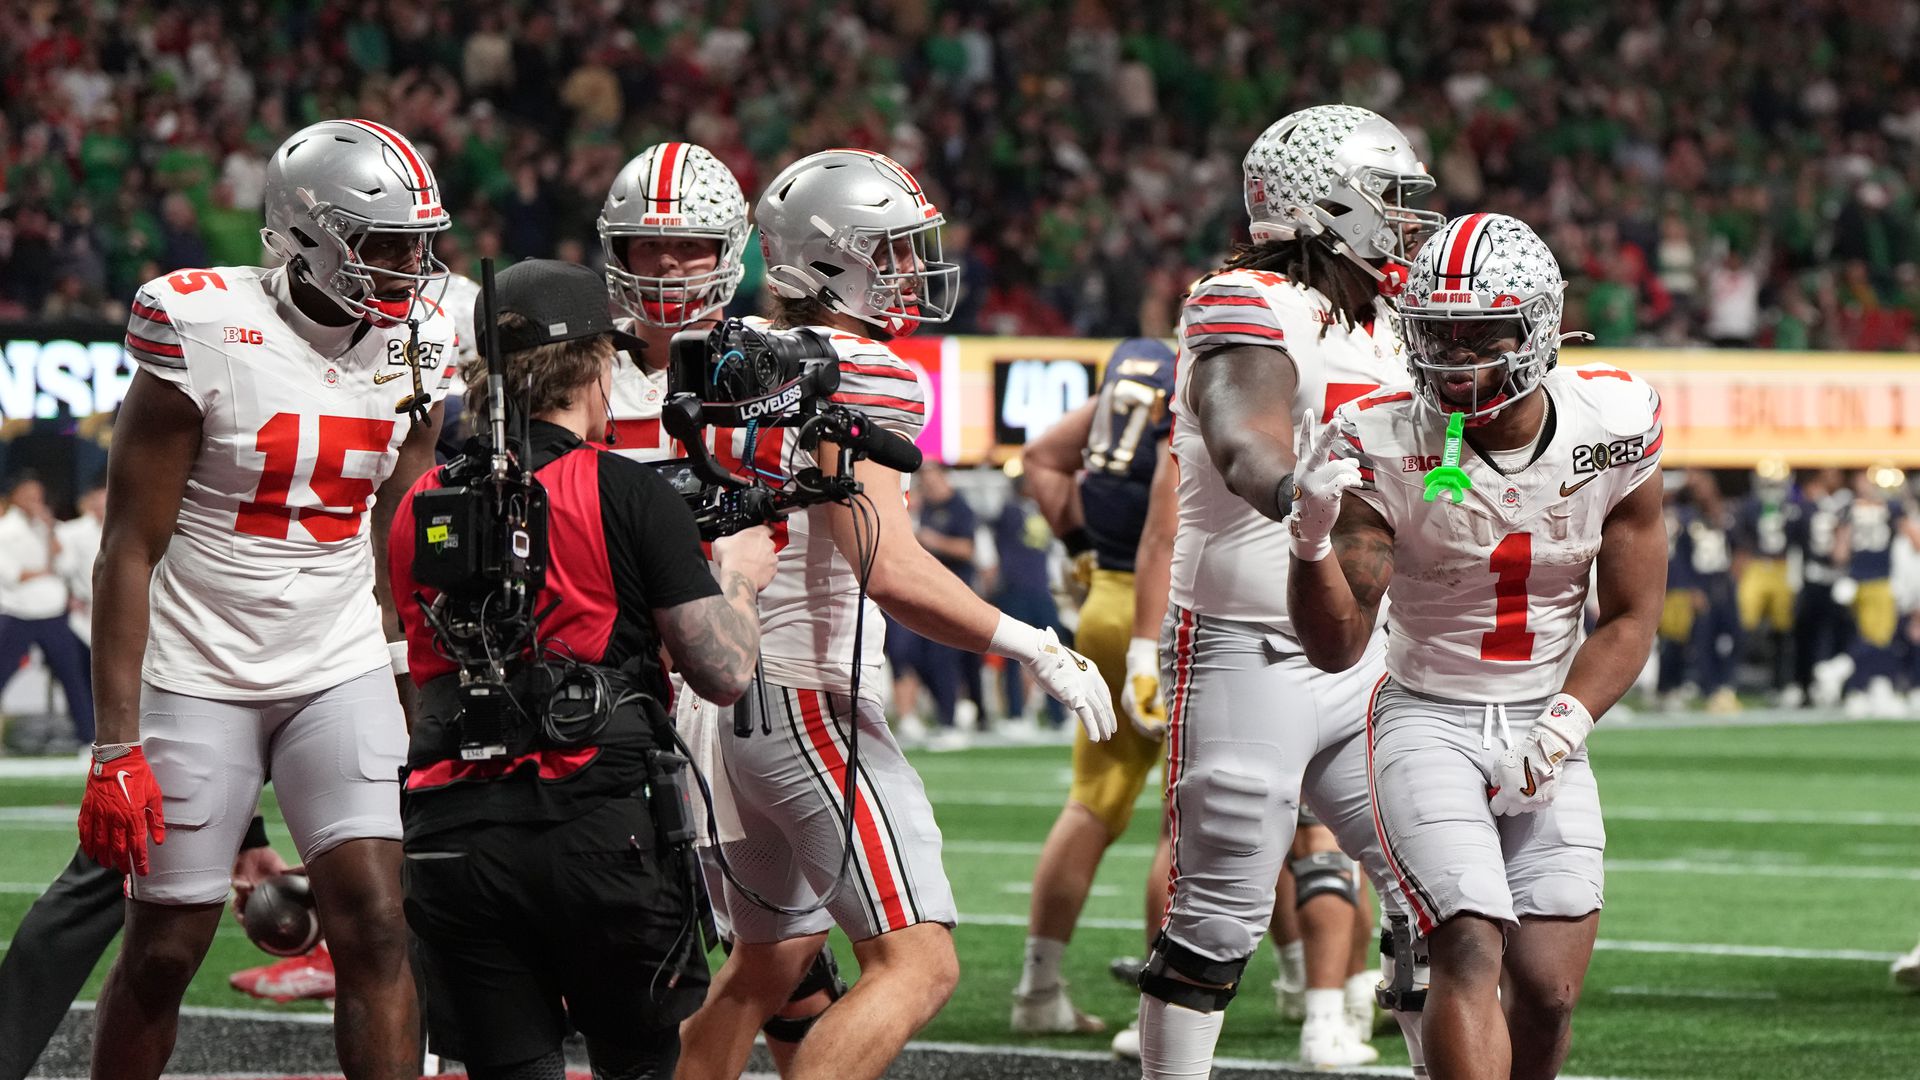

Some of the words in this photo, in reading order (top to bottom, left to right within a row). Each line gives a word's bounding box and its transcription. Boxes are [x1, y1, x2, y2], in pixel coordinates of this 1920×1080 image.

[1431, 293, 1448, 303] OHIO
[1449, 293, 1472, 304] STATE
[740, 384, 803, 421] LOVELESS
[1002, 359, 1091, 443] 40
[1443, 437, 1460, 467] NXTRND
[1572, 436, 1645, 475] 2025
[234, 411, 395, 543] 15
[1480, 532, 1536, 661] 1
